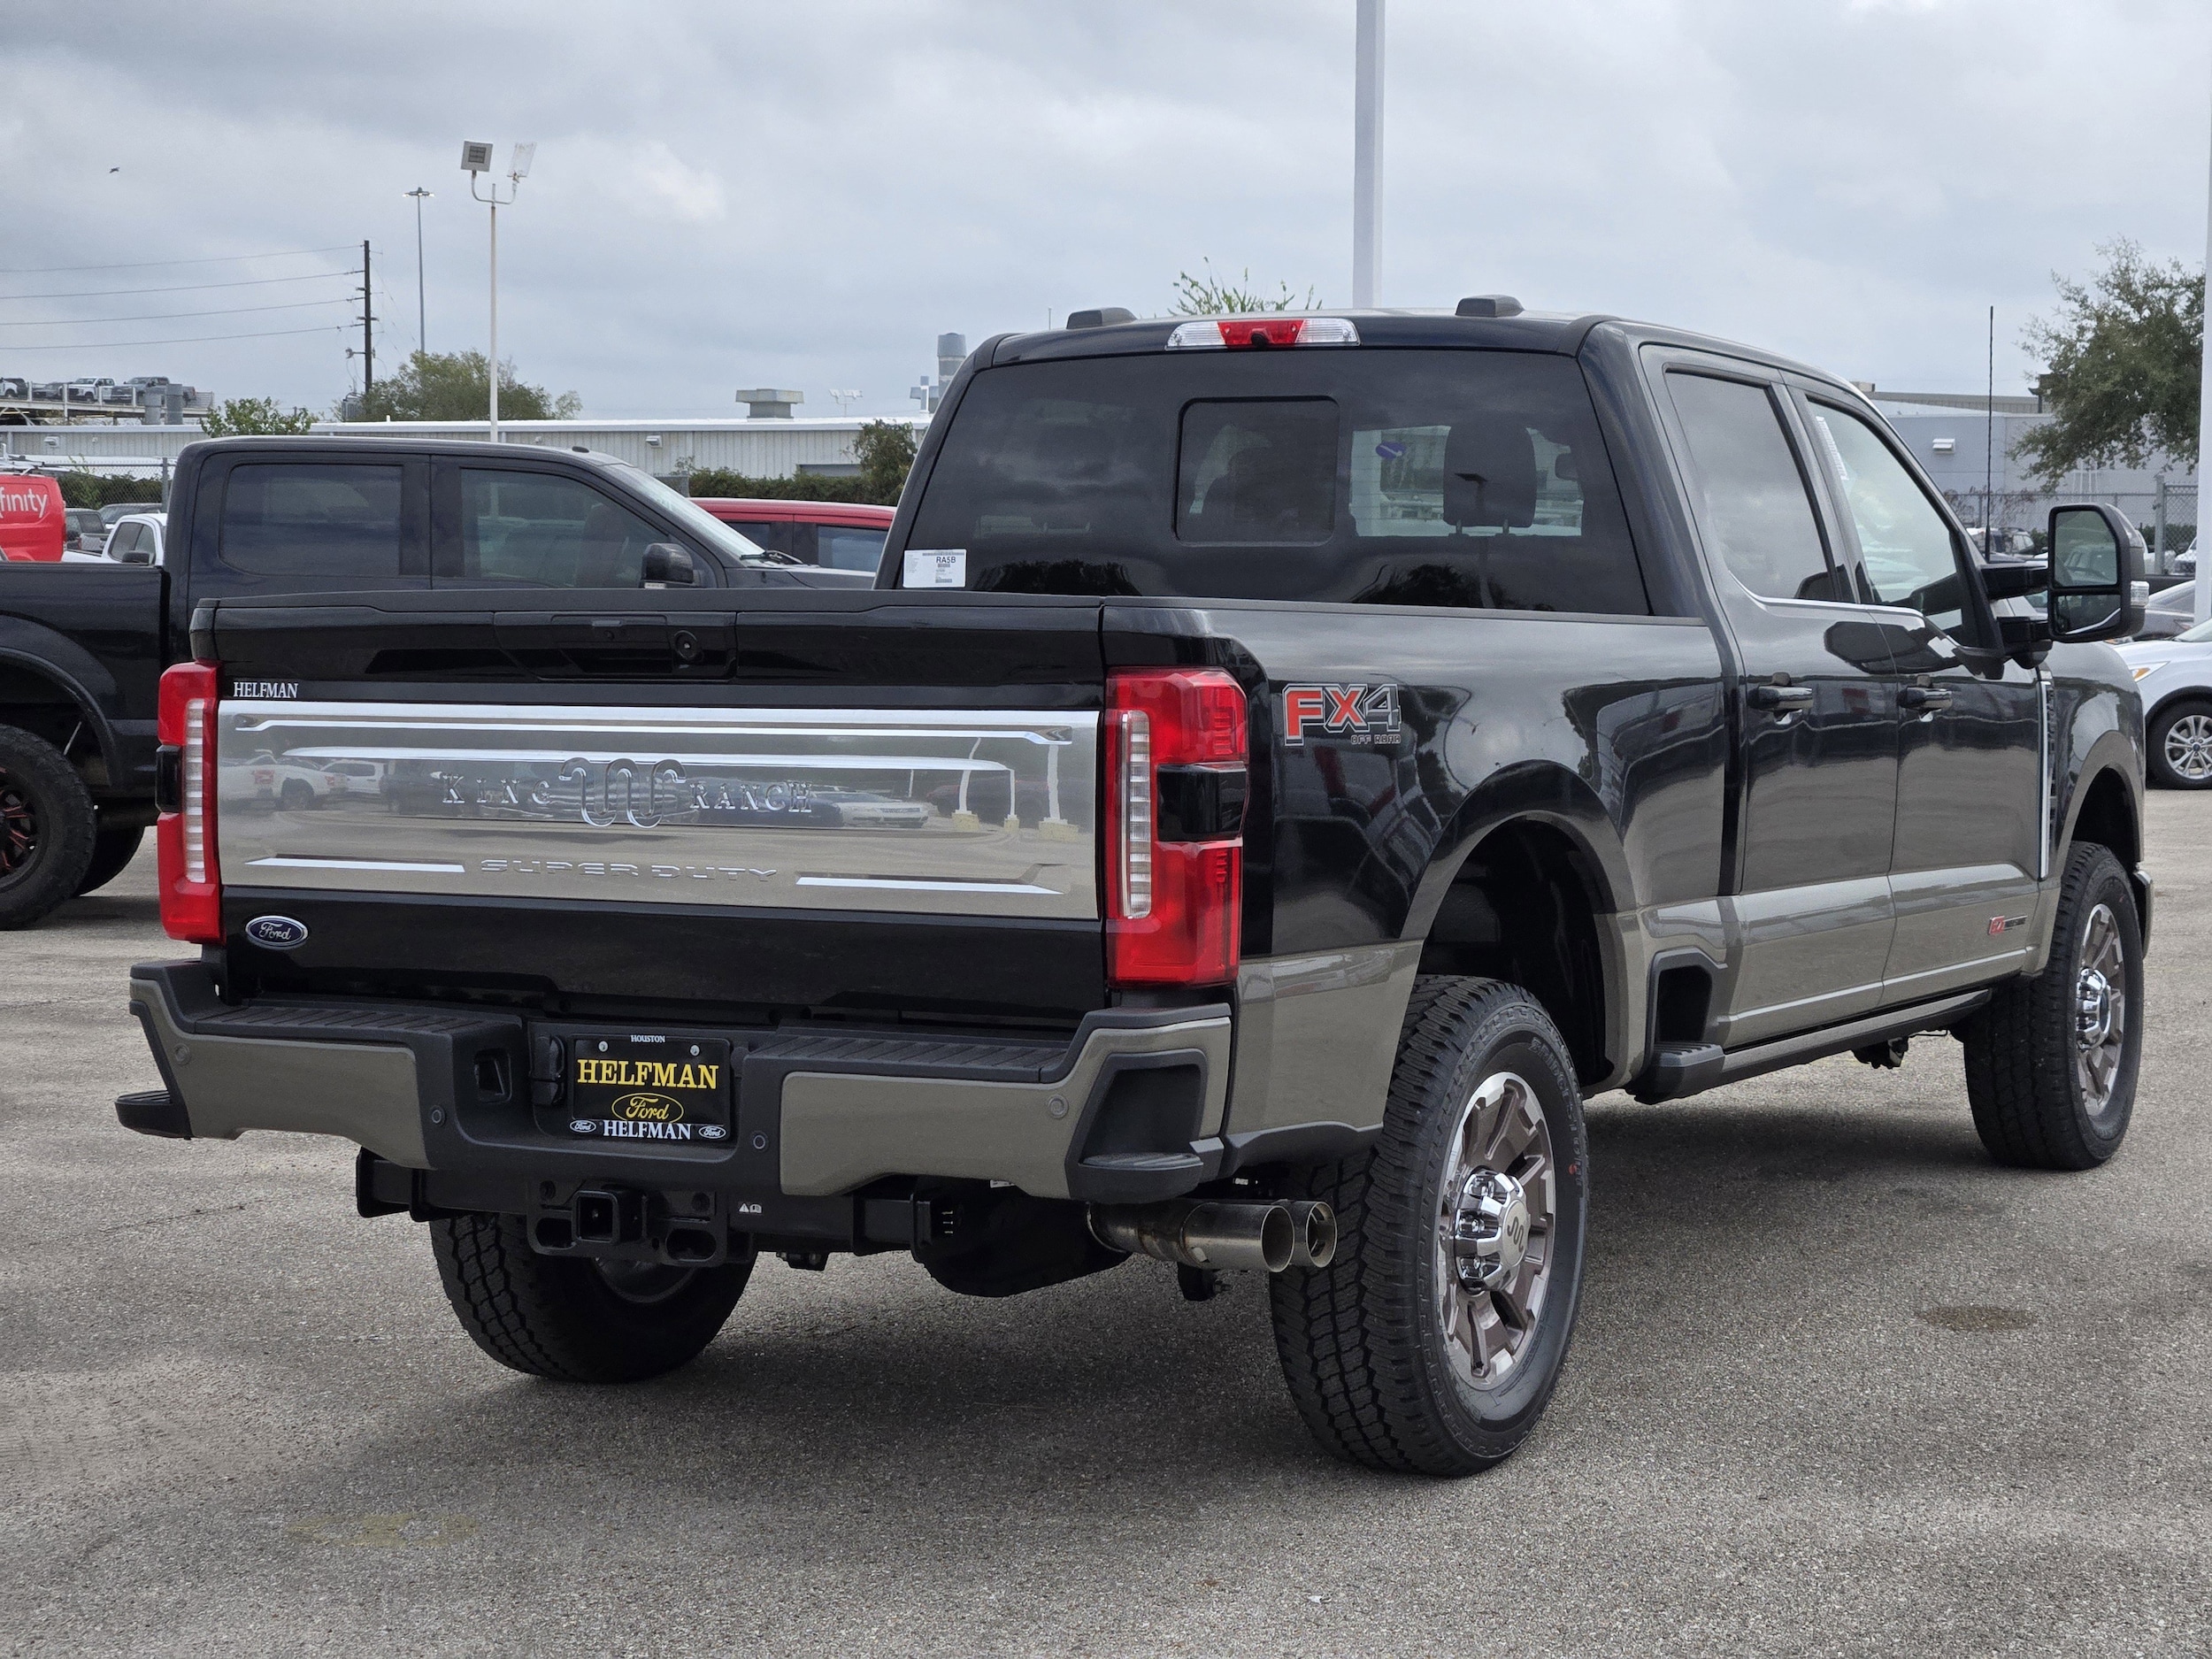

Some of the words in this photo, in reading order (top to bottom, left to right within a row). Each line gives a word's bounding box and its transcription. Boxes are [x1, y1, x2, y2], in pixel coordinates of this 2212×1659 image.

[0, 487, 48, 518] finity
[233, 681, 299, 699] HELFMAN
[1282, 683, 1402, 747] FX4
[1350, 734, 1372, 745] OFF
[442, 772, 551, 805] KING
[689, 781, 812, 813] RANCH
[480, 858, 639, 878] SUPER
[651, 864, 777, 882] DUTY
[630, 1034, 666, 1043] HOUSTON
[577, 1059, 719, 1090] HELFMAN
[626, 1095, 671, 1121] Ford
[603, 1119, 692, 1141] HELFMAN
